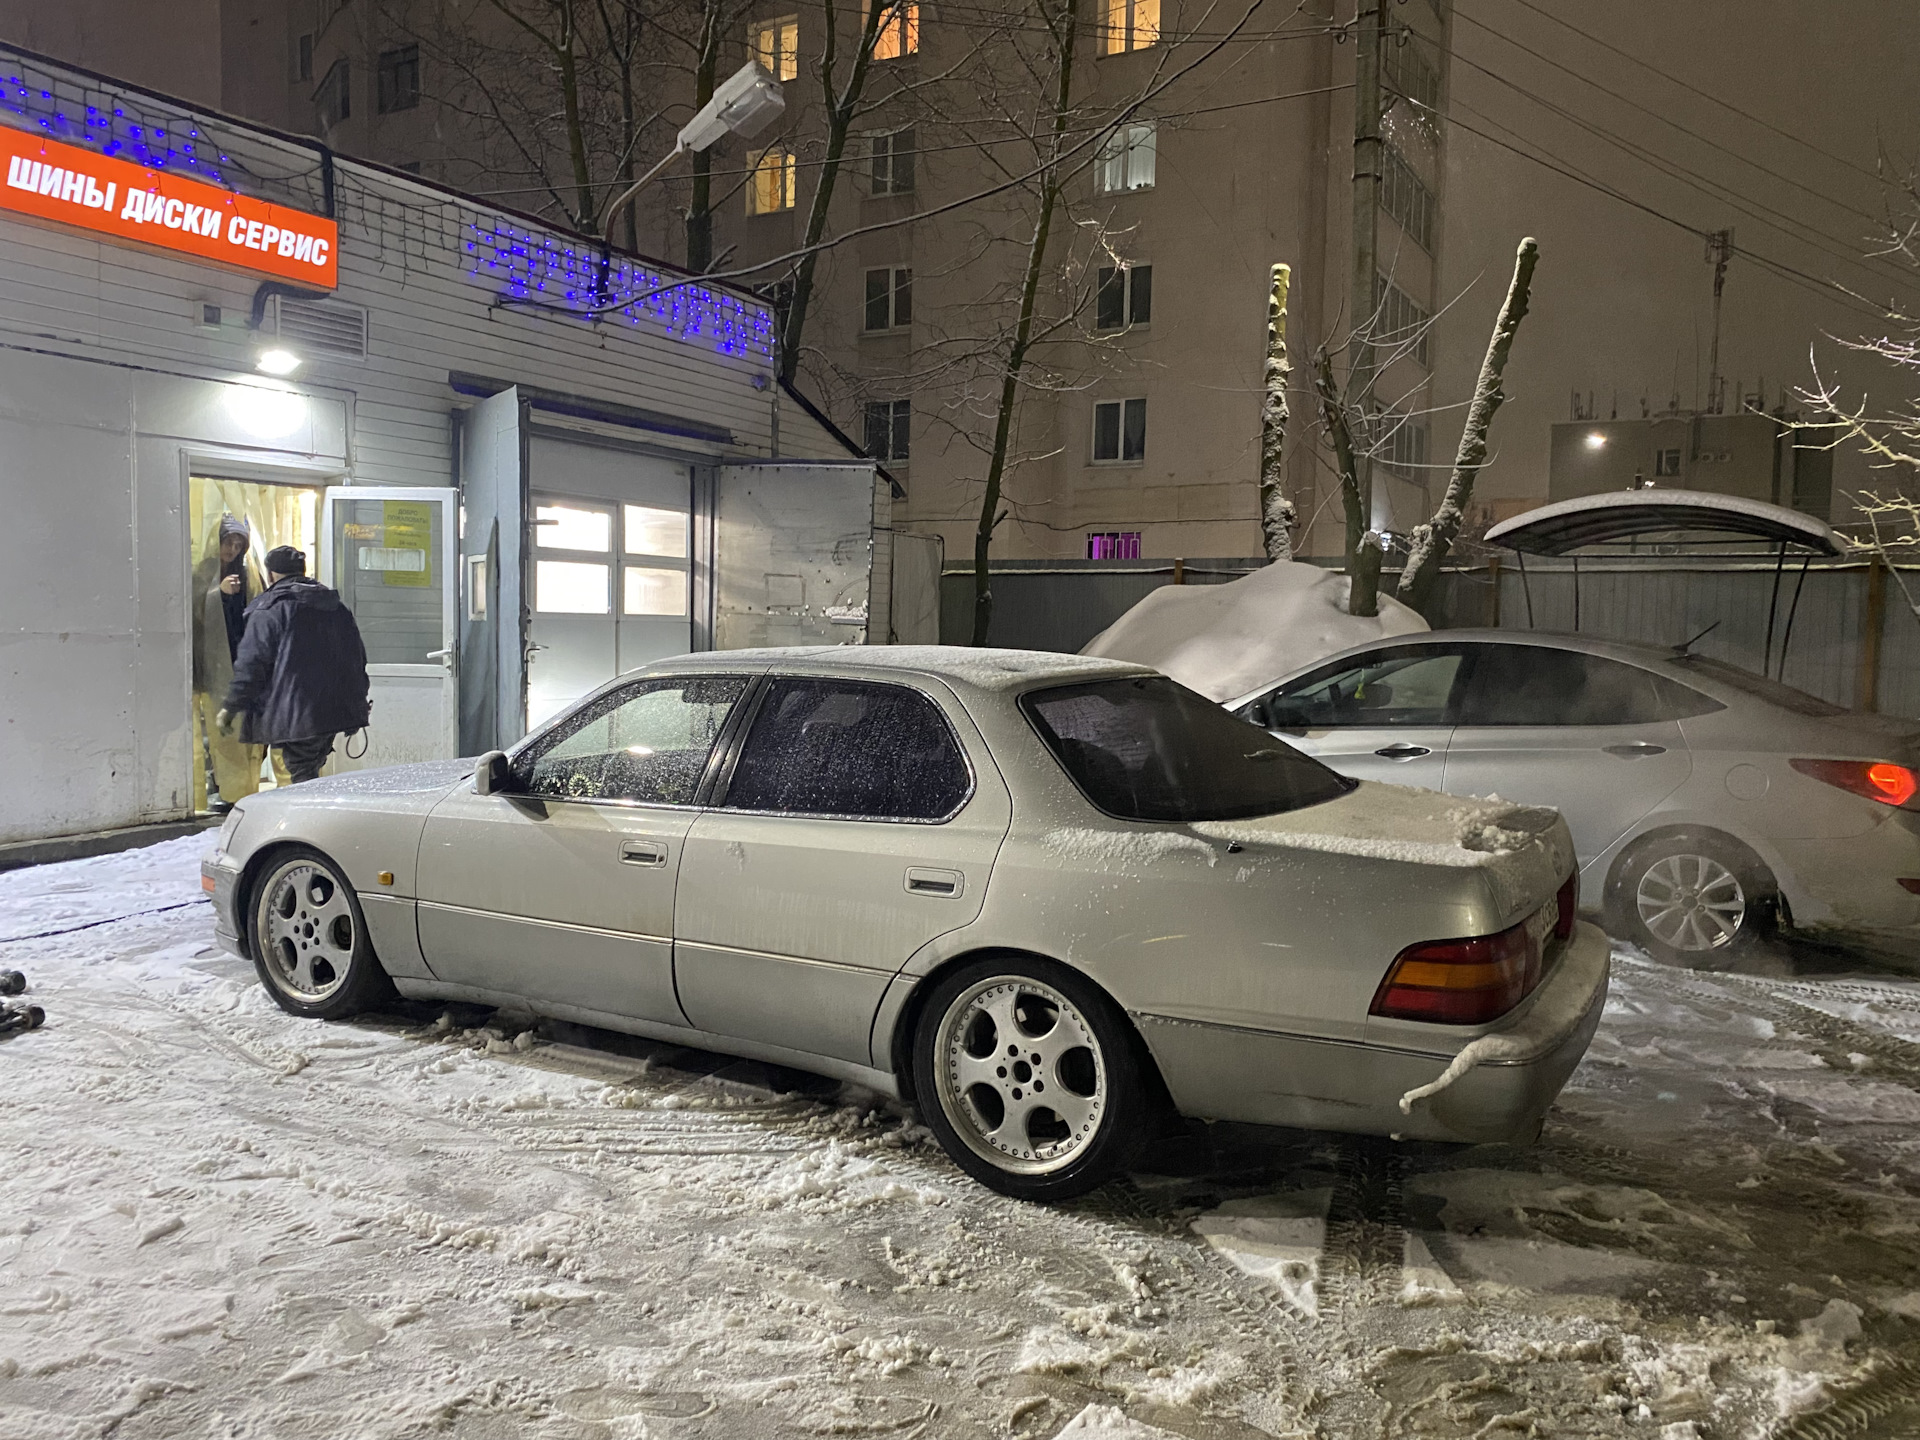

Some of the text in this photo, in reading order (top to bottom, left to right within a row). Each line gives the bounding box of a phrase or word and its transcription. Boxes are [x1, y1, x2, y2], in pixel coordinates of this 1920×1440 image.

[6, 155, 329, 266] ШИНЫ ДИСКИ СЕРВИС
